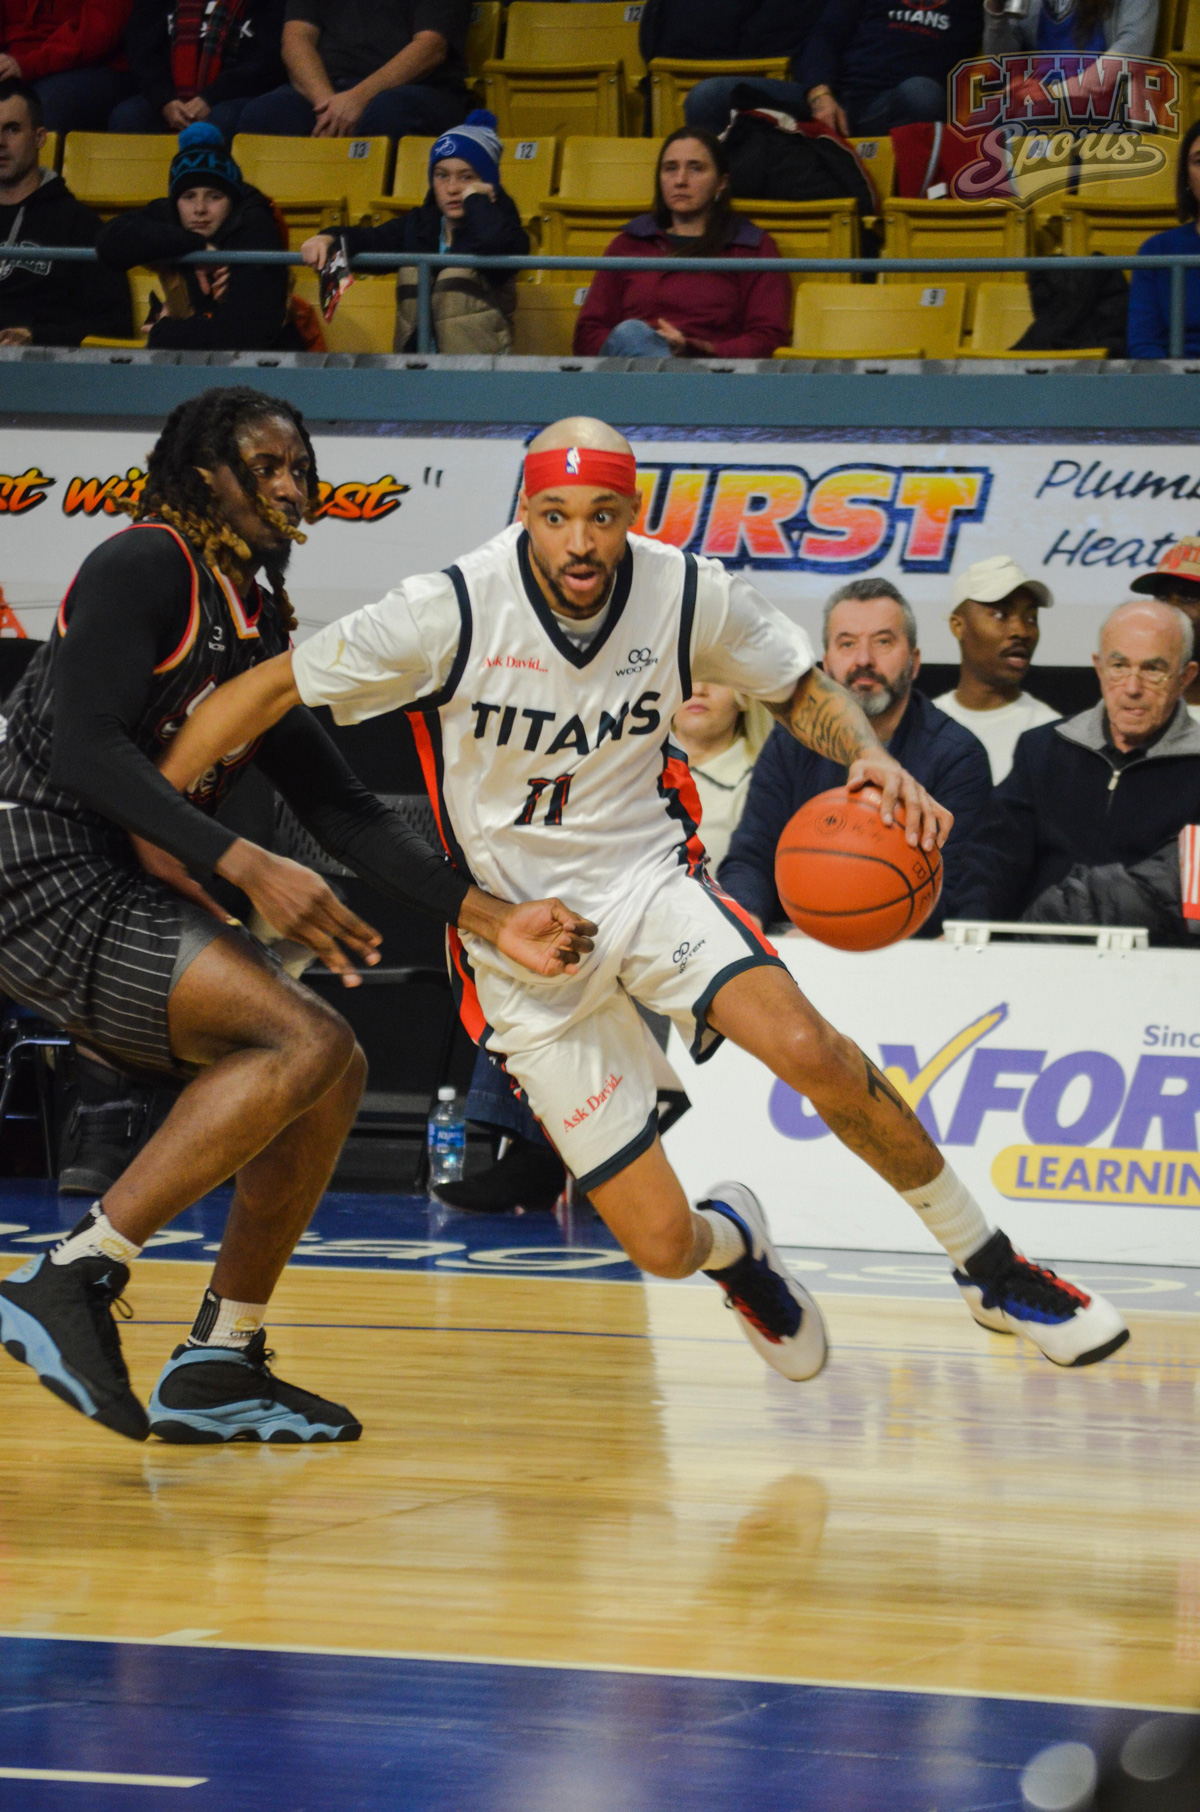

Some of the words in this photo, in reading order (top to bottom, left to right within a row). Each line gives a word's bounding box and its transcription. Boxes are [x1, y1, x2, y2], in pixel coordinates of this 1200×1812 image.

[520, 144, 533, 159] 12
[634, 462, 994, 575] URST
[1042, 528, 1182, 568] Heat
[471, 691, 661, 756] TITANS
[513, 772, 575, 826] 11
[562, 1107, 589, 1133] Ask
